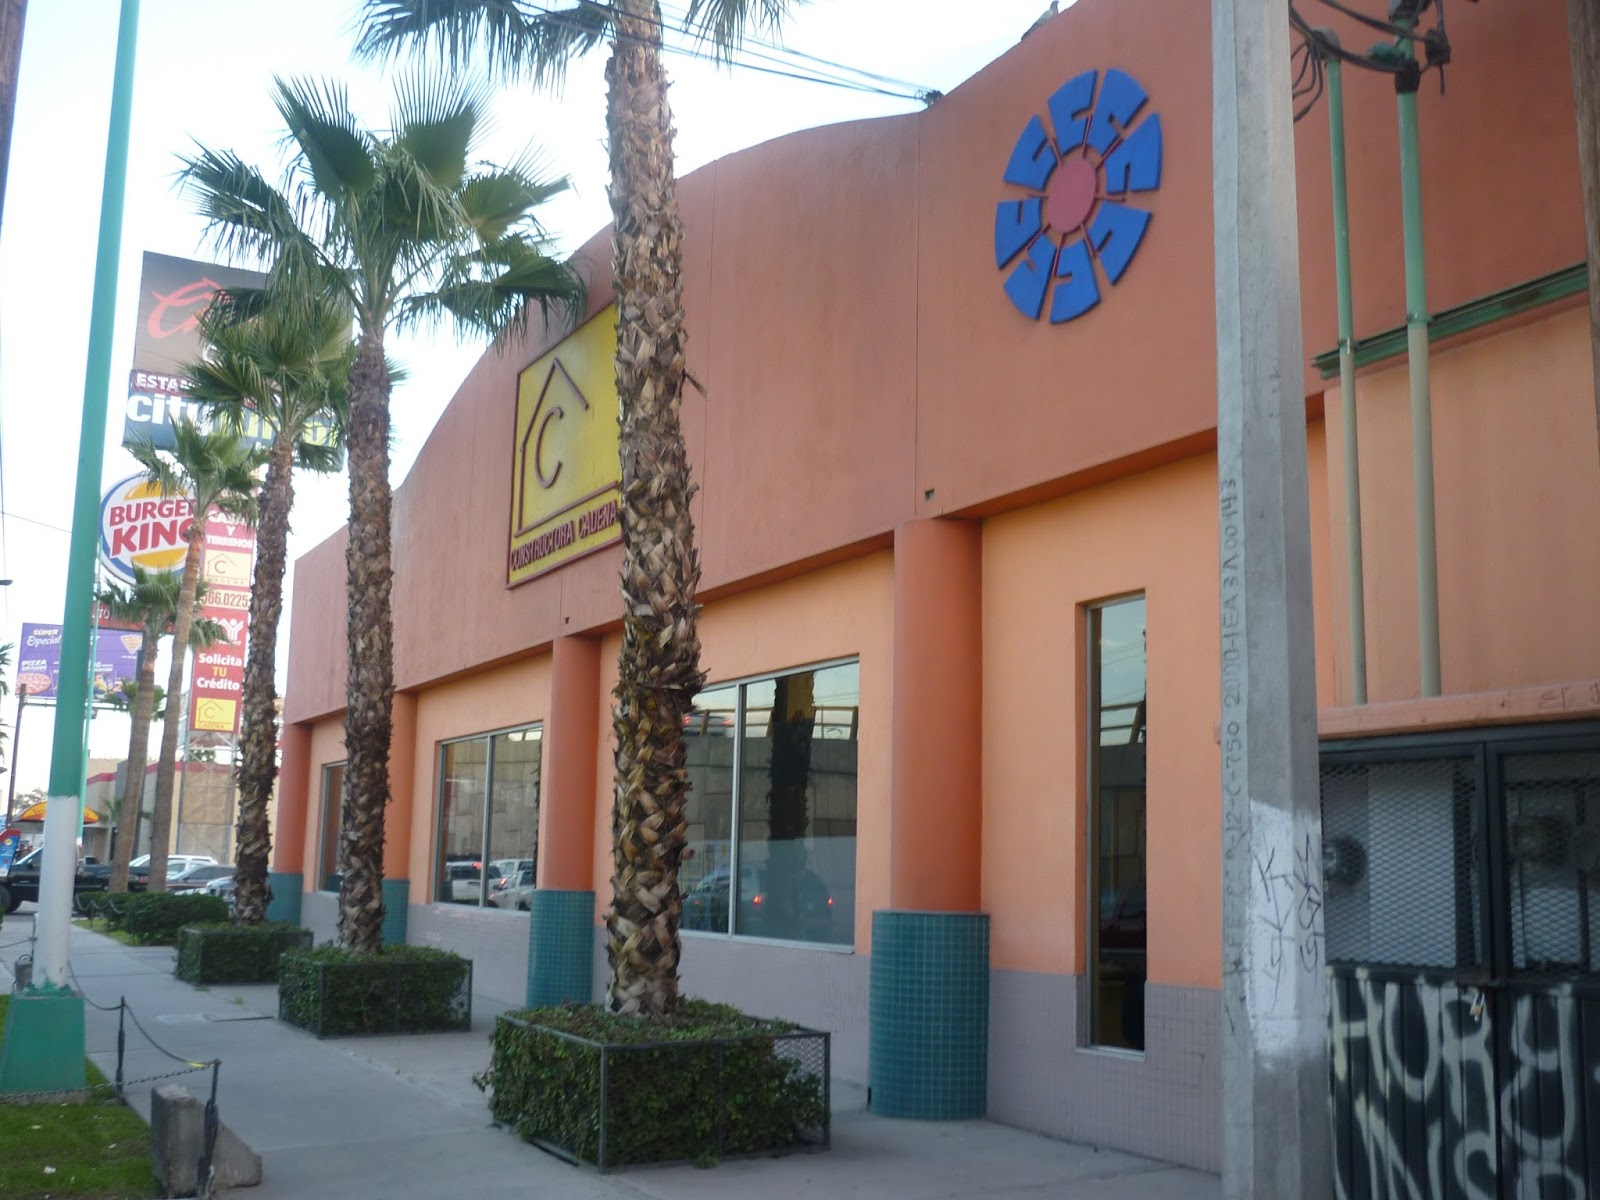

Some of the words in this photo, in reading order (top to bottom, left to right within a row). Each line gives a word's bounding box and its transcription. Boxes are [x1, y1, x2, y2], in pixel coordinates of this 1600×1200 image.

[226, 525, 236, 536] Y
[511, 520, 576, 571] CONSTRUCTORA
[578, 499, 617, 539] CADENA
[206, 535, 254, 549] TERRENOS
[198, 652, 242, 667] Solicita
[212, 666, 228, 677] TU
[196, 677, 240, 690] Crédito
